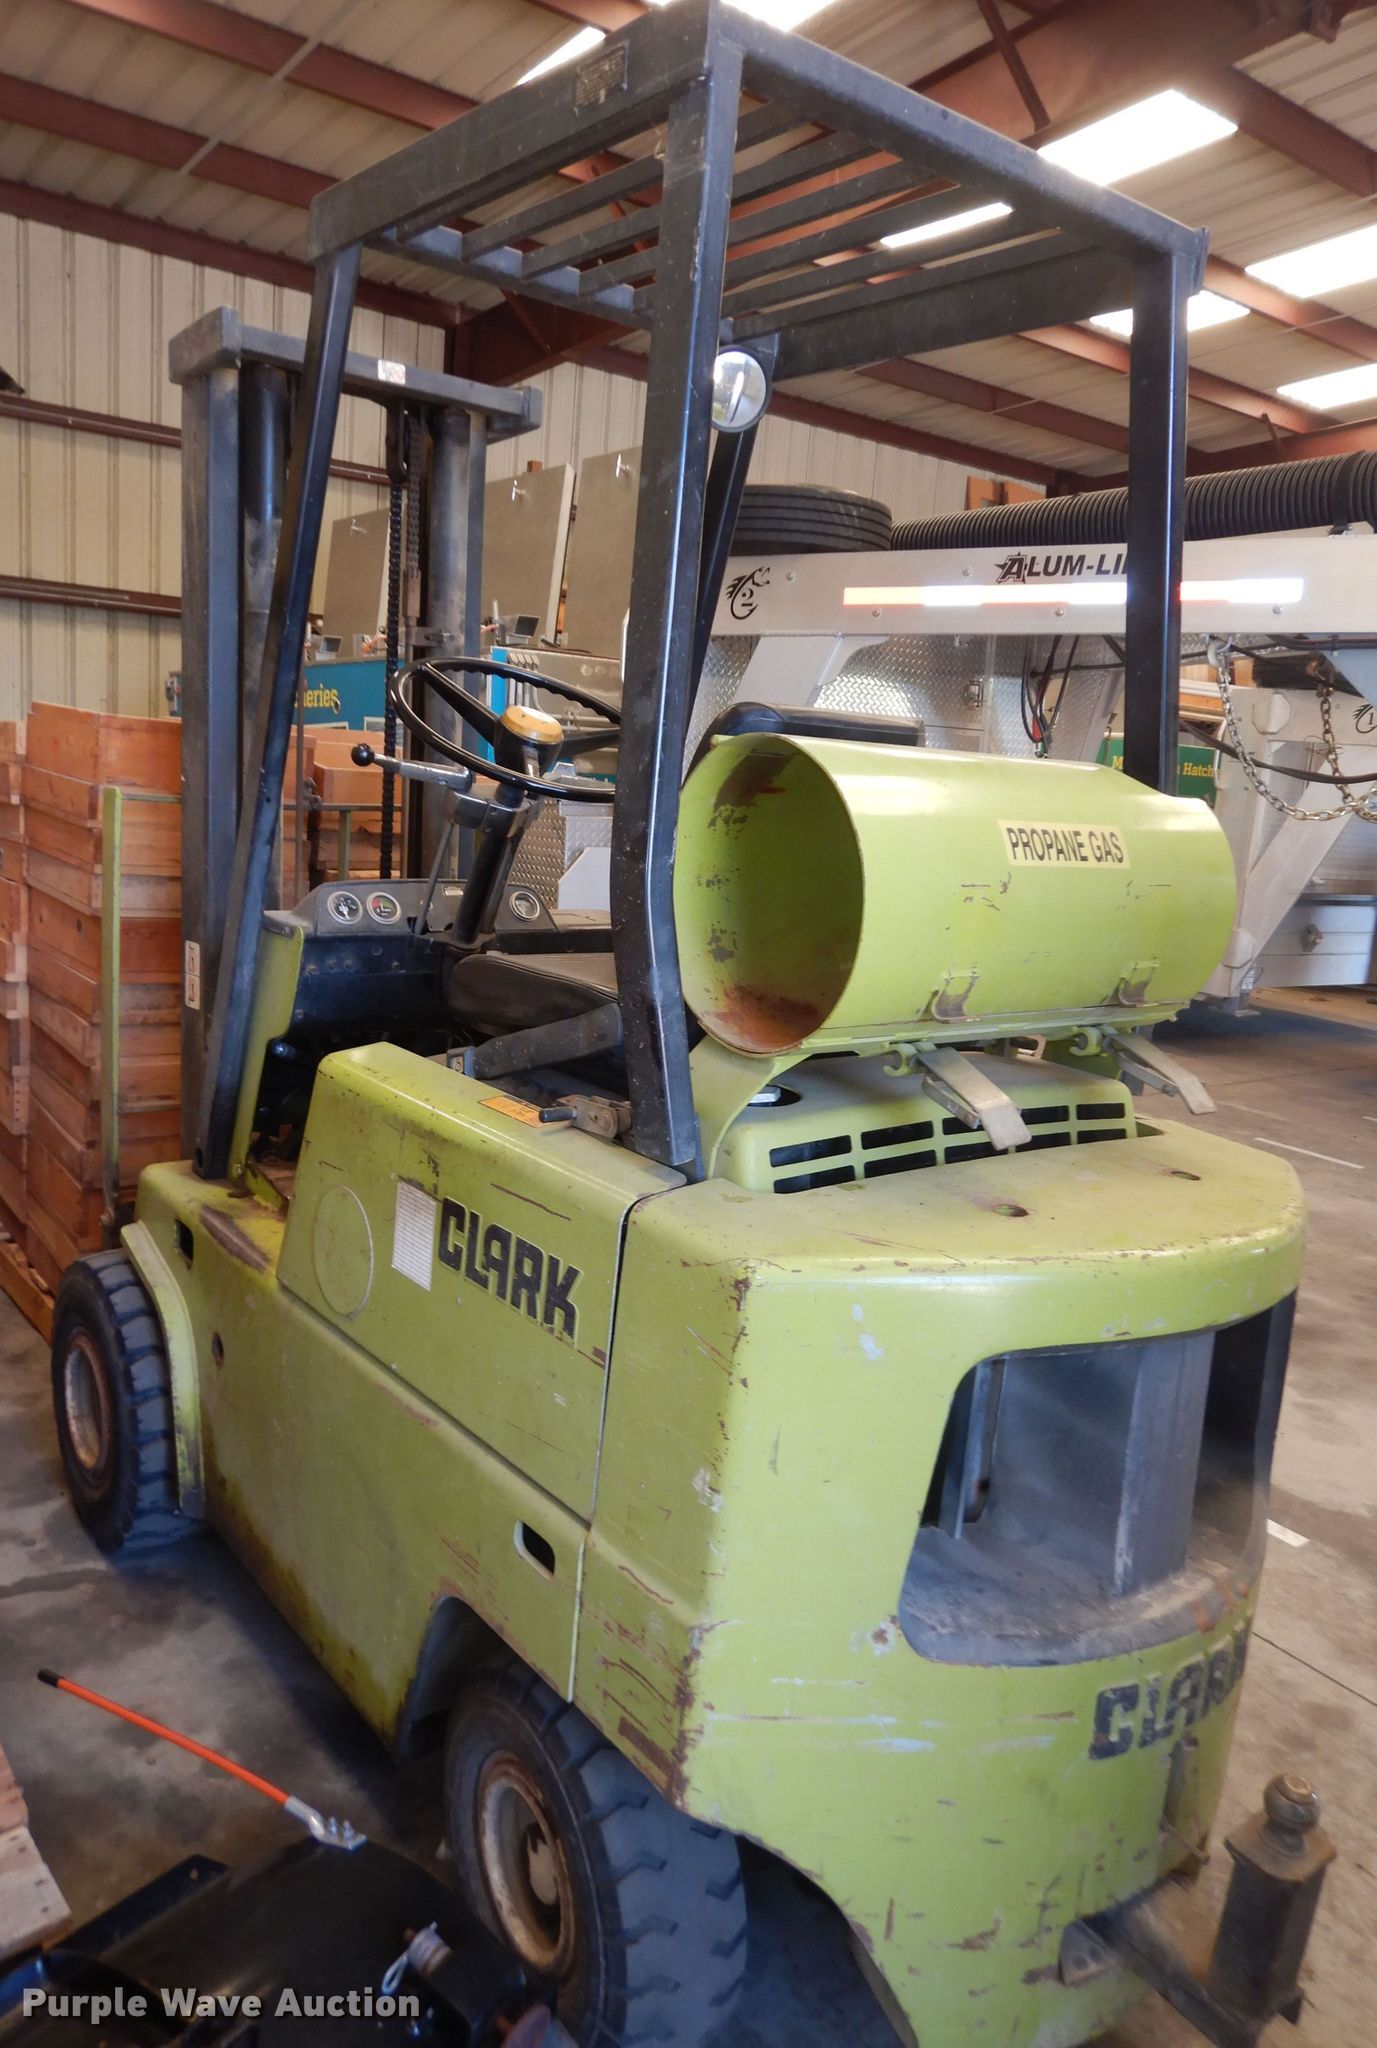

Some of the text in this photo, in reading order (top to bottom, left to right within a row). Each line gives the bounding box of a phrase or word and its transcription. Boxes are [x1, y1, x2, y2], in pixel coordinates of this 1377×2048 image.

[995, 552, 1127, 584] ALUM-LI
[1006, 827, 1124, 863] PROPANE GAS
[438, 1197, 583, 1344] CLARK
